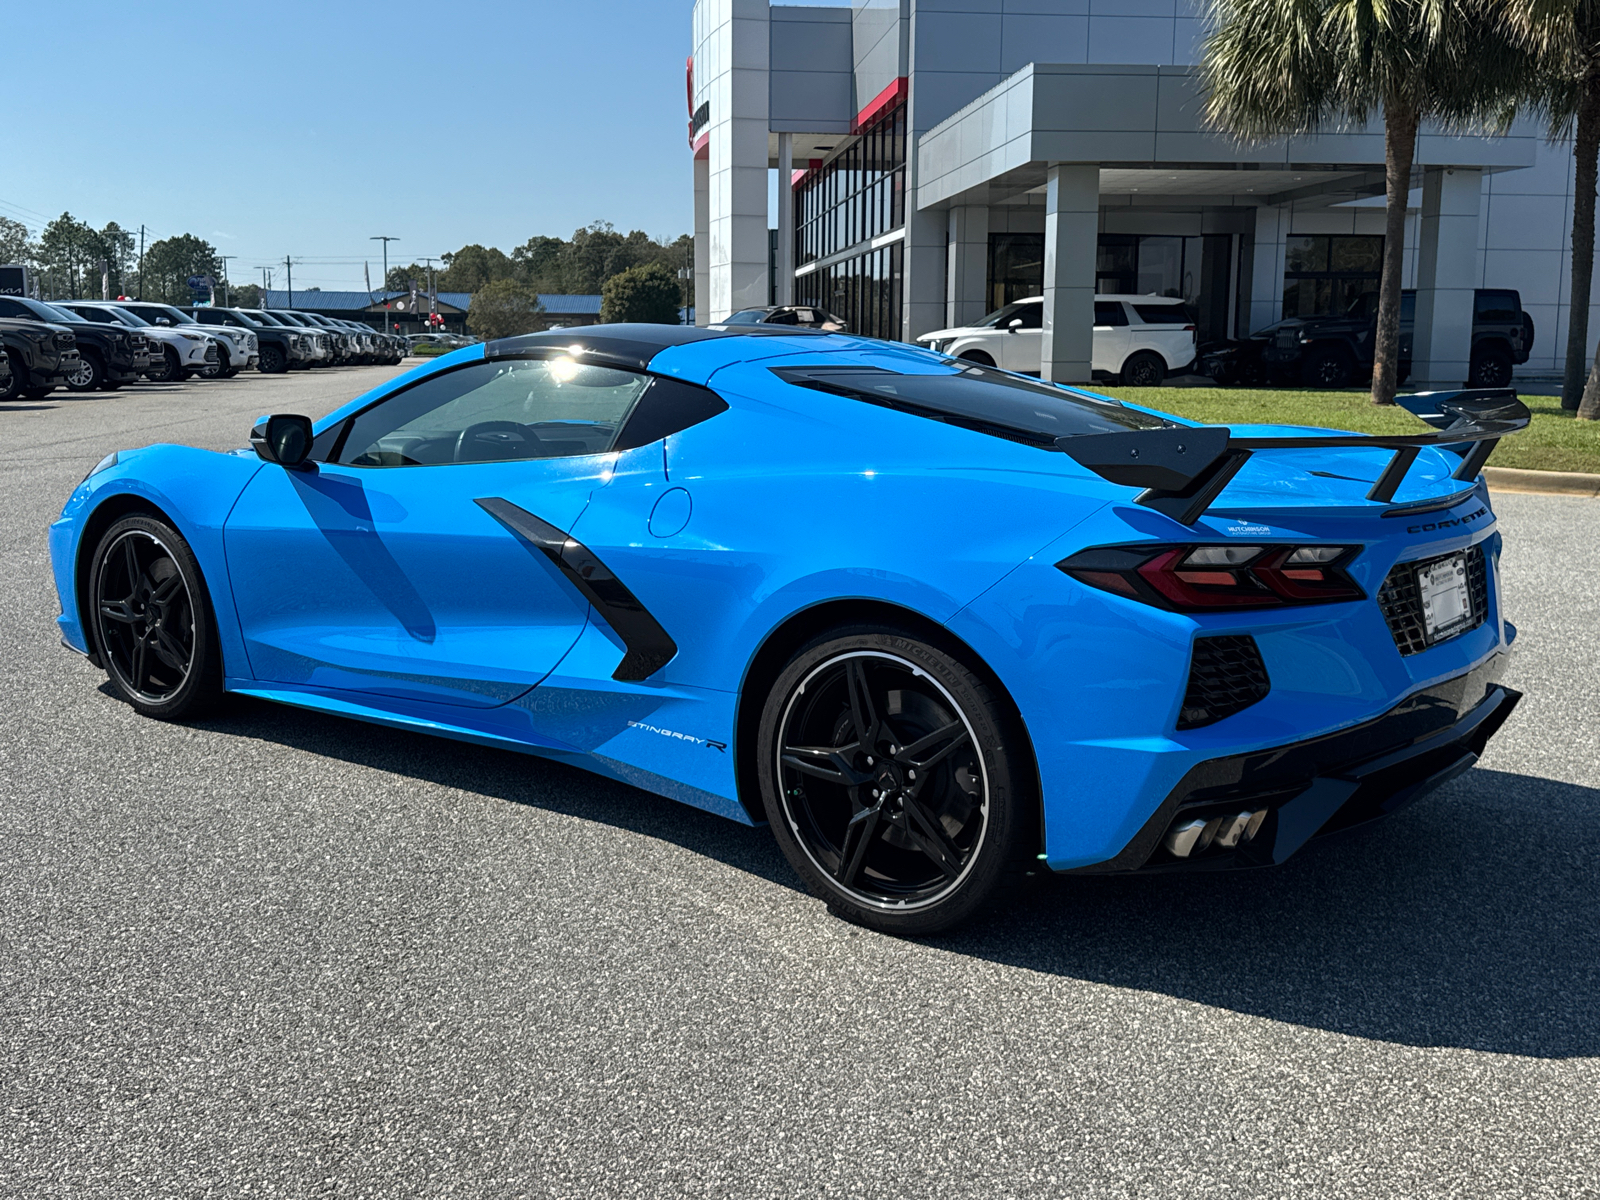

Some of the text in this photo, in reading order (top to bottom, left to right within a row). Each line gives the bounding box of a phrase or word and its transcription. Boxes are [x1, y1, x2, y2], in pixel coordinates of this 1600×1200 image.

[1407, 506, 1488, 534] CORVETTE
[895, 639, 963, 687] MICHELIN
[627, 720, 727, 753] STINGRAY R
[797, 865, 859, 916] MICHELIN
